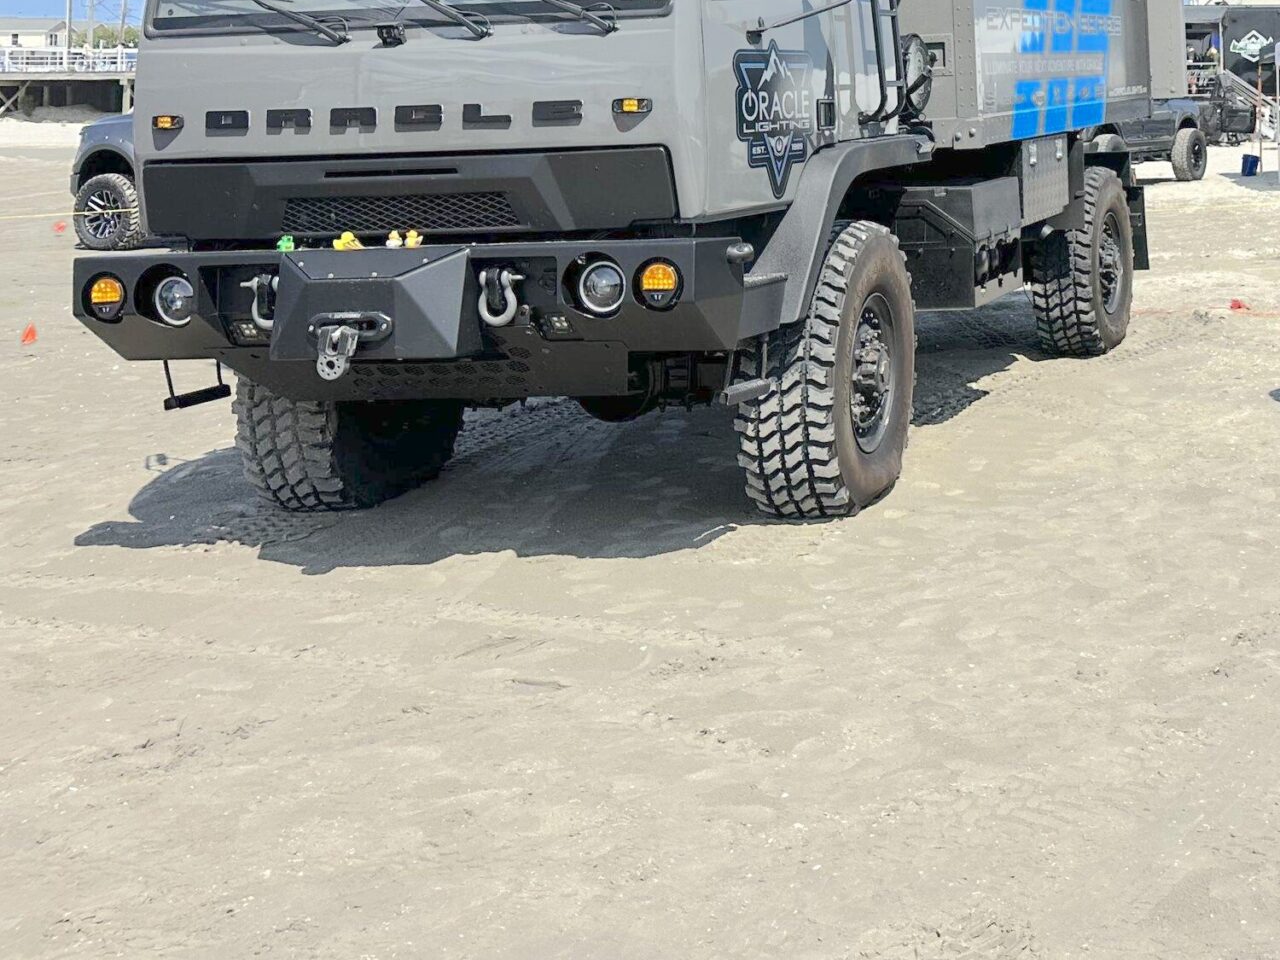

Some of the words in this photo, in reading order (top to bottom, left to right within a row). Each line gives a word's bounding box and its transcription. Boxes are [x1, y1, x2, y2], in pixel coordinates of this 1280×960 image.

[742, 89, 810, 121] ORACLE
[205, 100, 584, 136] ORACLE
[743, 120, 810, 133] LIGHTING
[752, 145, 767, 155] EST.
